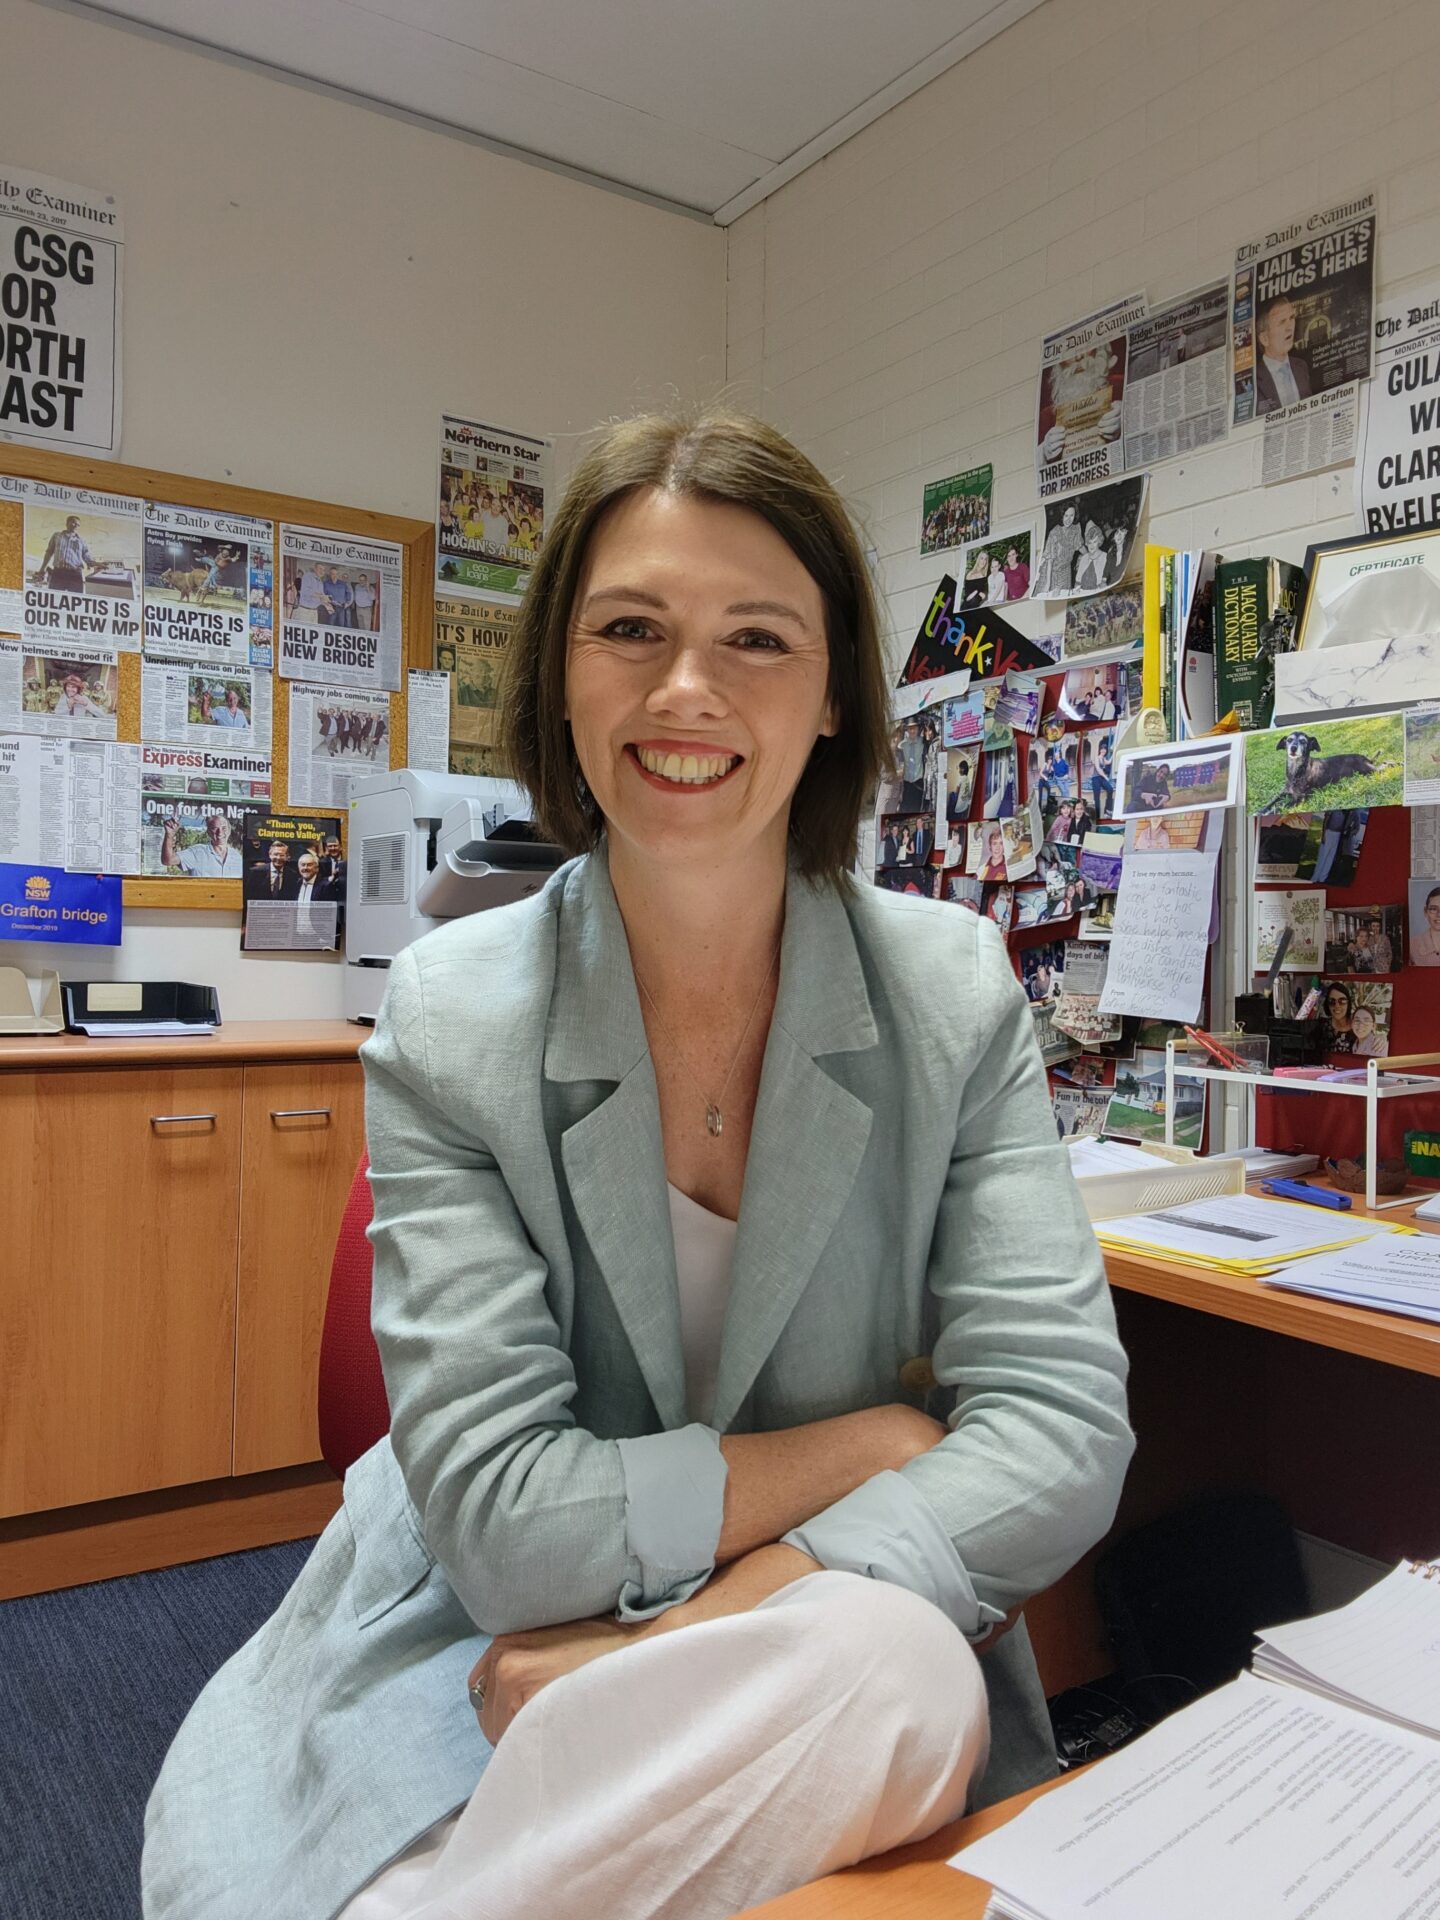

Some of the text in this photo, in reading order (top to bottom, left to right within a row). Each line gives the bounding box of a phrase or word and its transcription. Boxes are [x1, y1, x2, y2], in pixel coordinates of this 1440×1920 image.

[12, 205, 35, 216] March
[51, 216, 67, 225] 2017
[26, 187, 116, 225] Examiner
[1237, 194, 1374, 261] The Daily Examiner
[14, 226, 94, 285] CSG
[1257, 220, 1371, 282] JAIL STATE'S
[1257, 243, 1369, 301] THUGS HERE
[1, 272, 56, 326] OR
[1043, 305, 1145, 359] The Daily Examiner
[1129, 327, 1153, 342] Bridge
[1154, 315, 1178, 332] finally
[1179, 304, 1200, 320] ready
[1375, 300, 1440, 338] The Dail
[0, 323, 86, 383] RTH
[1394, 338, 1428, 357] MONDAY,
[0, 375, 83, 431] AST
[1265, 407, 1287, 424] Send
[1288, 402, 1308, 418] yobs
[1310, 398, 1320, 408] to
[1321, 386, 1354, 405] Grafton
[445, 428, 511, 454] Northern
[514, 446, 541, 462] Star
[1039, 448, 1108, 483] THREE CHEERS
[1, 476, 140, 512] The Daily Examiner
[1040, 463, 1110, 498] FOR PROGRESS
[145, 510, 272, 540] The Daily Examiner
[165, 531, 176, 540] Boy
[284, 536, 399, 566] The Daily Examiner
[441, 533, 497, 554] HOGAN'S
[499, 545, 507, 557] A
[25, 590, 130, 618] GULAPTIS IS
[145, 604, 243, 632] GULAPTIS IS
[435, 600, 456, 615] The
[461, 604, 489, 622] Daily
[25, 609, 139, 636] OUR NEW MP
[145, 621, 231, 647] IN CHARGE
[436, 622, 508, 648] IT'S HOW
[925, 591, 994, 675] thank
[1224, 587, 1240, 663] DICTIONARY
[1241, 584, 1258, 662] MACQUARIE
[0, 643, 113, 662] New helmets are good fit
[283, 625, 377, 653] HELP DESIGN
[199, 661, 220, 672] focus
[222, 665, 232, 673] on
[234, 664, 251, 676] jobs
[283, 642, 374, 668] NEW BRIDGE
[292, 684, 389, 704] Highway jobs coming soon
[3, 752, 15, 761] hit
[146, 800, 174, 815] One
[177, 802, 198, 816] for
[201, 804, 224, 816] the
[258, 828, 295, 839] Clarence
[298, 822, 316, 831] you,
[25, 889, 50, 899] NSW
[0, 903, 108, 924] Grafton bridge
[1067, 951, 1083, 960] days
[1094, 953, 1105, 962] big
[1056, 1092, 1070, 1102] Fun
[1073, 1092, 1080, 1102] in
[1417, 1141, 1440, 1158] NA
